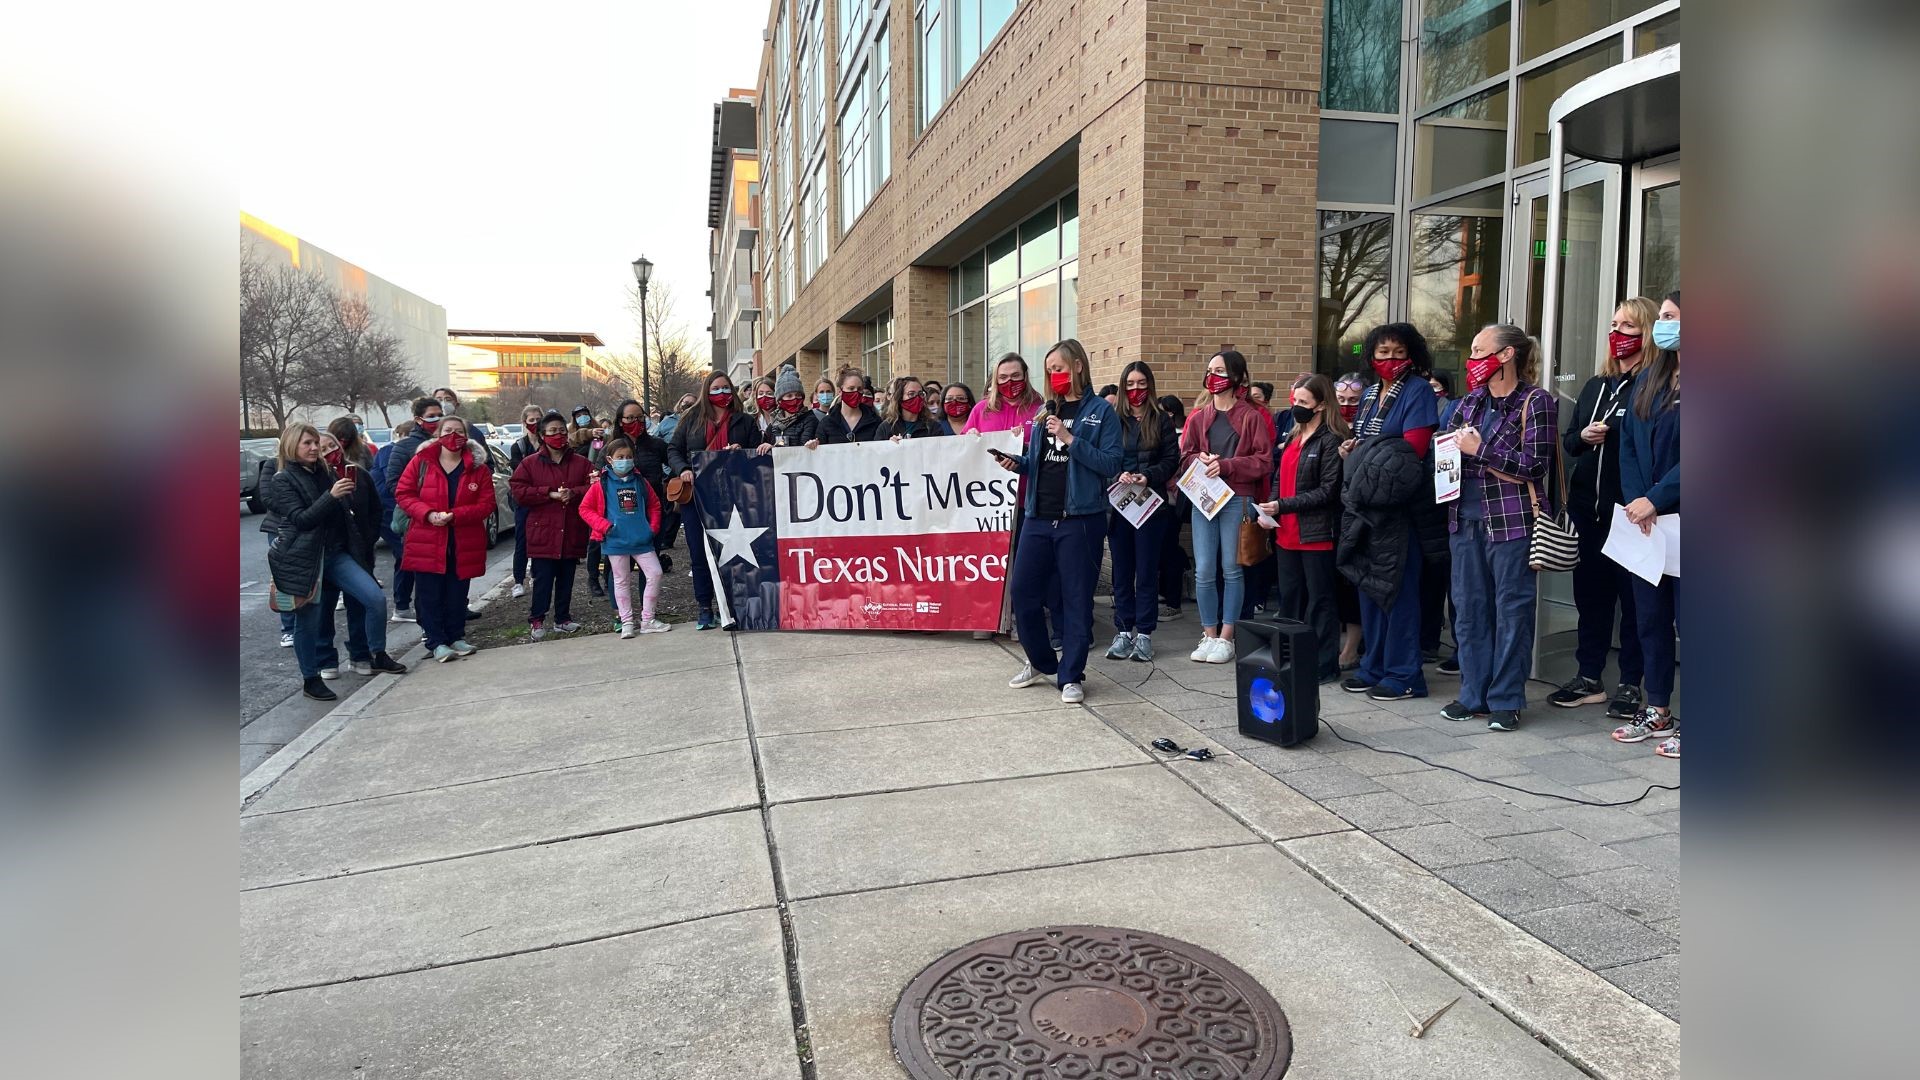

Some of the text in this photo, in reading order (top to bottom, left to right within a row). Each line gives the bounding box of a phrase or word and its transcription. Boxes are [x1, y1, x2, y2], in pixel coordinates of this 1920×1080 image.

[781, 466, 1018, 523] Don't Mess
[788, 547, 889, 584] Texas
